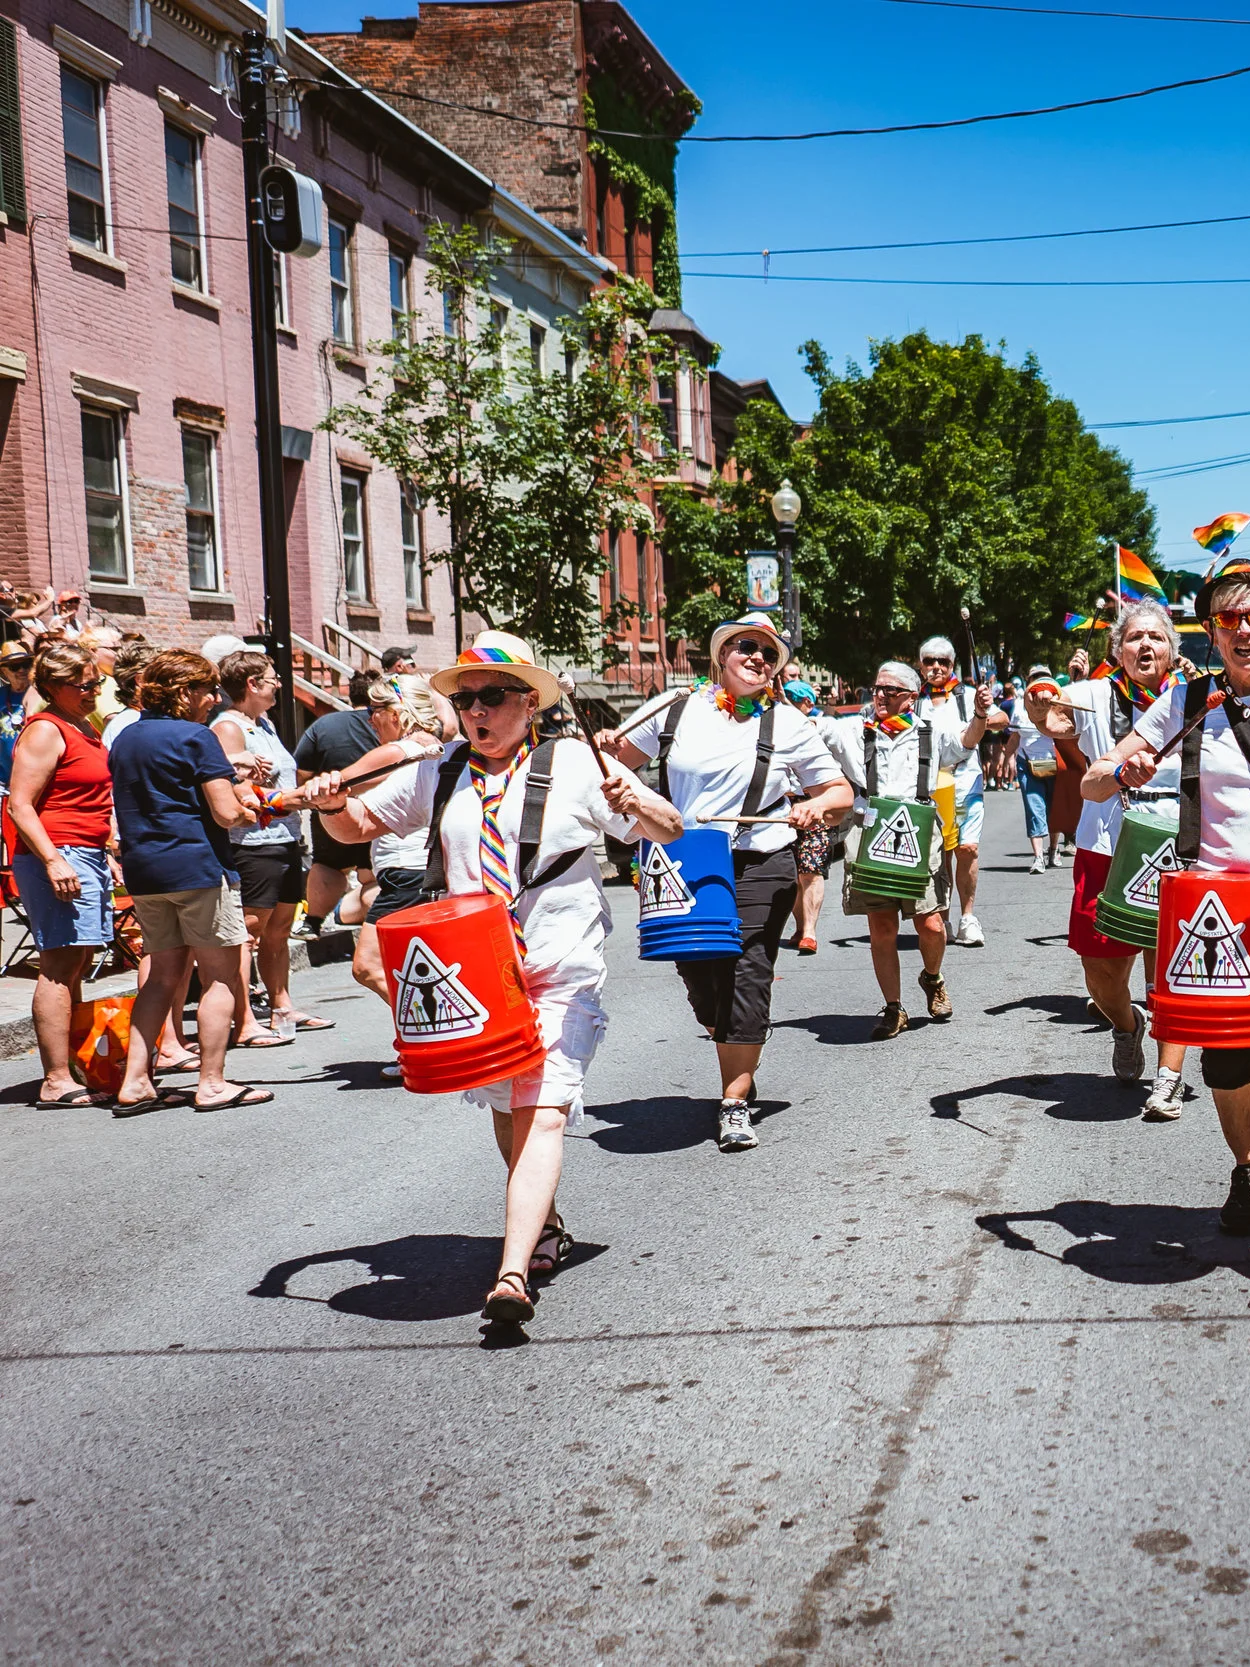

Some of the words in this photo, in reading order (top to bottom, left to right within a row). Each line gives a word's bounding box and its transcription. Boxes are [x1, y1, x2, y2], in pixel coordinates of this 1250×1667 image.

[1177, 940, 1195, 966] RHYTHM
[1227, 944, 1243, 969] WOMYN
[413, 975, 437, 984] UPSTATE
[444, 986, 467, 1011] WOMYN
